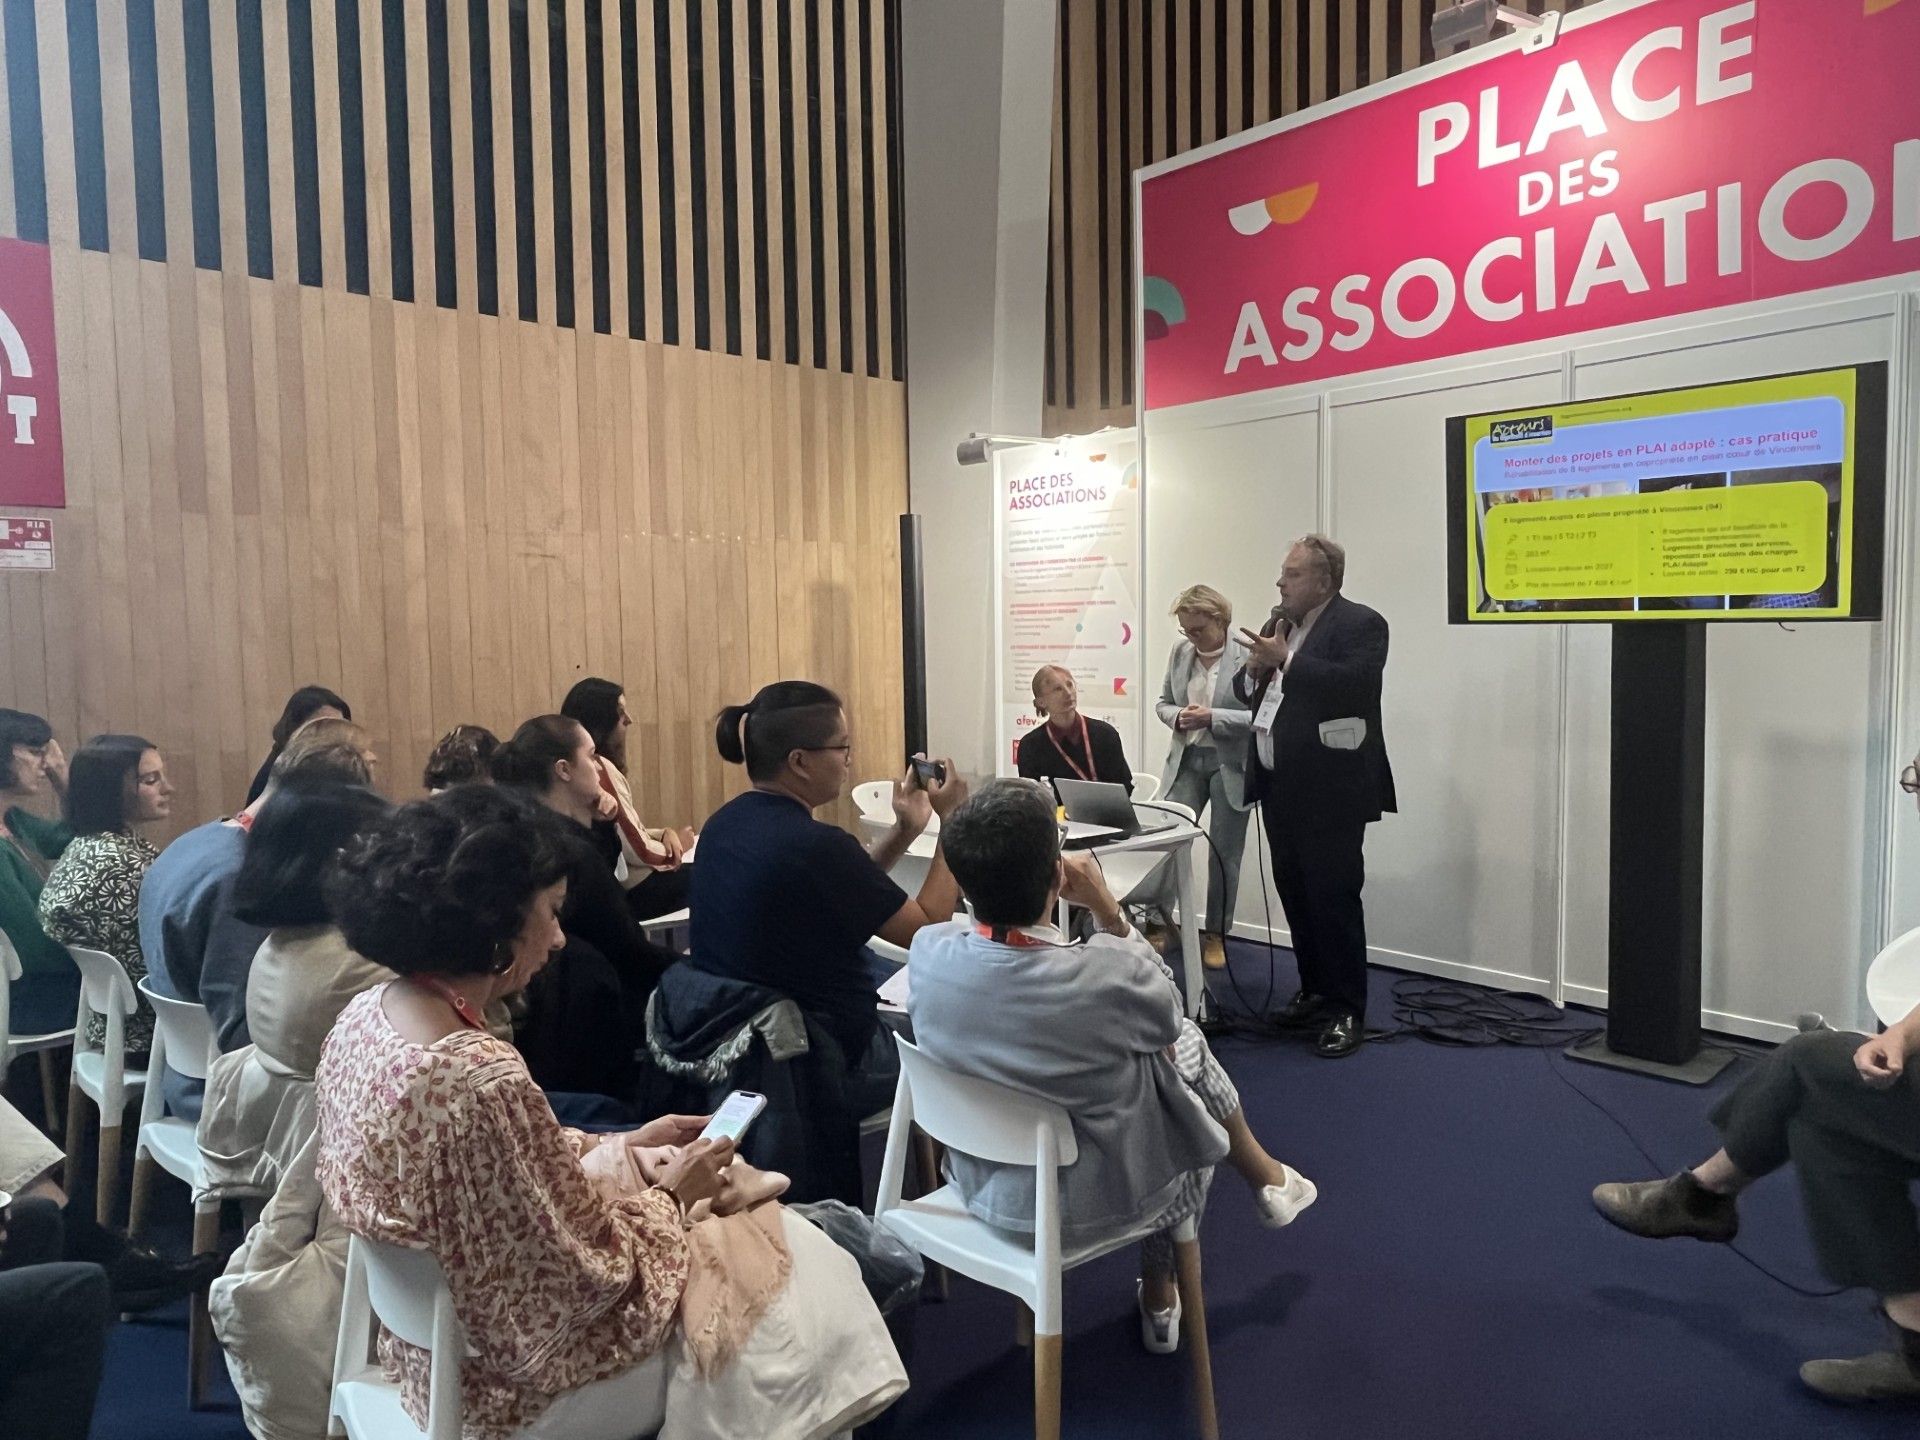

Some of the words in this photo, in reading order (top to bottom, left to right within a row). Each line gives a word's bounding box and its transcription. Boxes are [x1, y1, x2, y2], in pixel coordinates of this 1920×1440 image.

[1417, 0, 1756, 187] PLACE
[1518, 149, 1620, 217] DES
[1492, 418, 1545, 438] Acteurs
[1504, 457, 1543, 468] Monter
[1546, 453, 1568, 465] des
[1571, 449, 1613, 466] projets
[1617, 448, 1632, 457] en
[1636, 442, 1667, 455] PLAI
[1670, 437, 1715, 453] adapté
[1728, 436, 1753, 447] cas
[1757, 428, 1818, 446] pratique
[1622, 460, 1634, 468] en
[1687, 454, 1699, 463] en
[1701, 452, 1724, 462] plein
[1754, 448, 1766, 457] de
[1769, 443, 1821, 456] Vincennes
[1009, 476, 1046, 494] PLACE
[1050, 472, 1073, 488] DES
[1009, 486, 1106, 511] ASSOCIATIONS
[1509, 515, 1547, 525] logements
[1659, 504, 1703, 513] Vincennes
